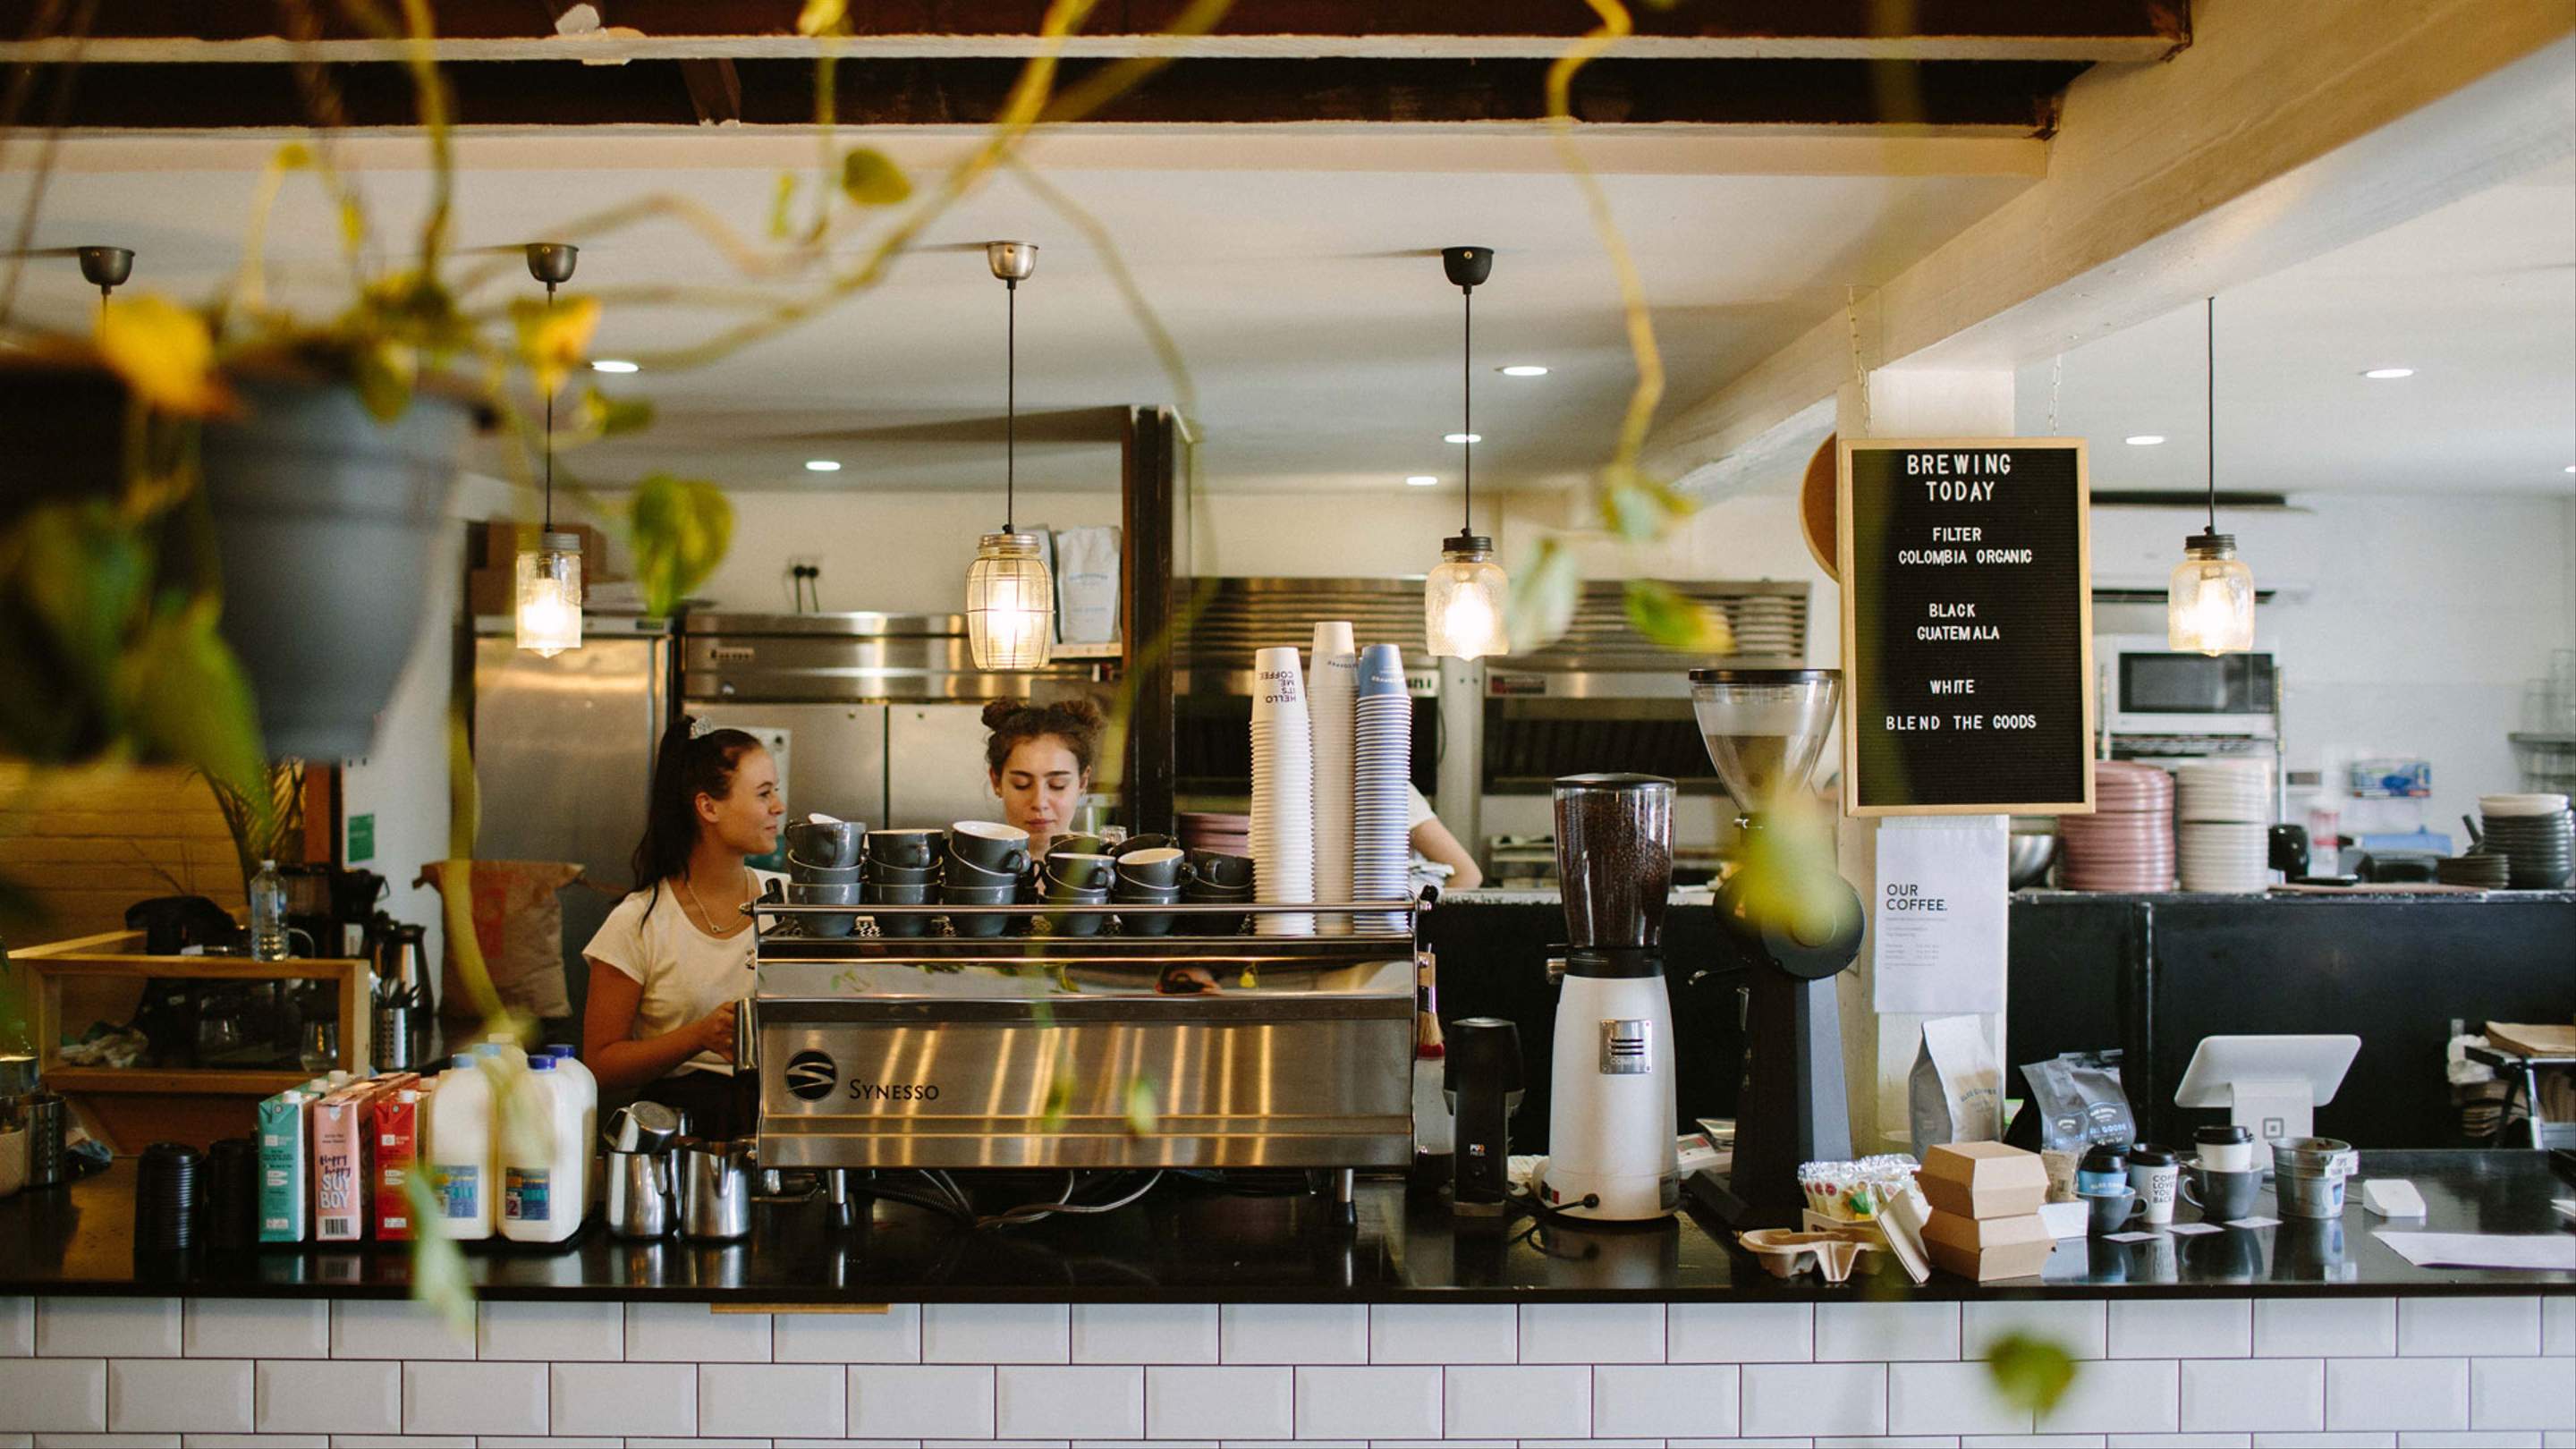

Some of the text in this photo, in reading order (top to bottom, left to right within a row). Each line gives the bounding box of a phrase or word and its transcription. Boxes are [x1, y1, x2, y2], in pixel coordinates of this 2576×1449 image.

[1908, 454, 2011, 474] BREWING
[1926, 481, 1994, 502] TODAY
[1933, 528, 1981, 541] FILTER
[1899, 549, 2032, 565] COLOMBIA ORGANIC
[1929, 604, 1975, 617] BLACK
[1917, 626, 1999, 640] GUATEMALA
[1930, 680, 1974, 693] WHITE
[1886, 715, 2037, 730] BLEND THE GOODS
[1886, 883, 1919, 896] OUR
[1885, 898, 1947, 911] COFFEE.
[322, 1175, 352, 1192] SOY
[320, 1191, 350, 1208] BOY
[507, 1199, 518, 1216] 2
